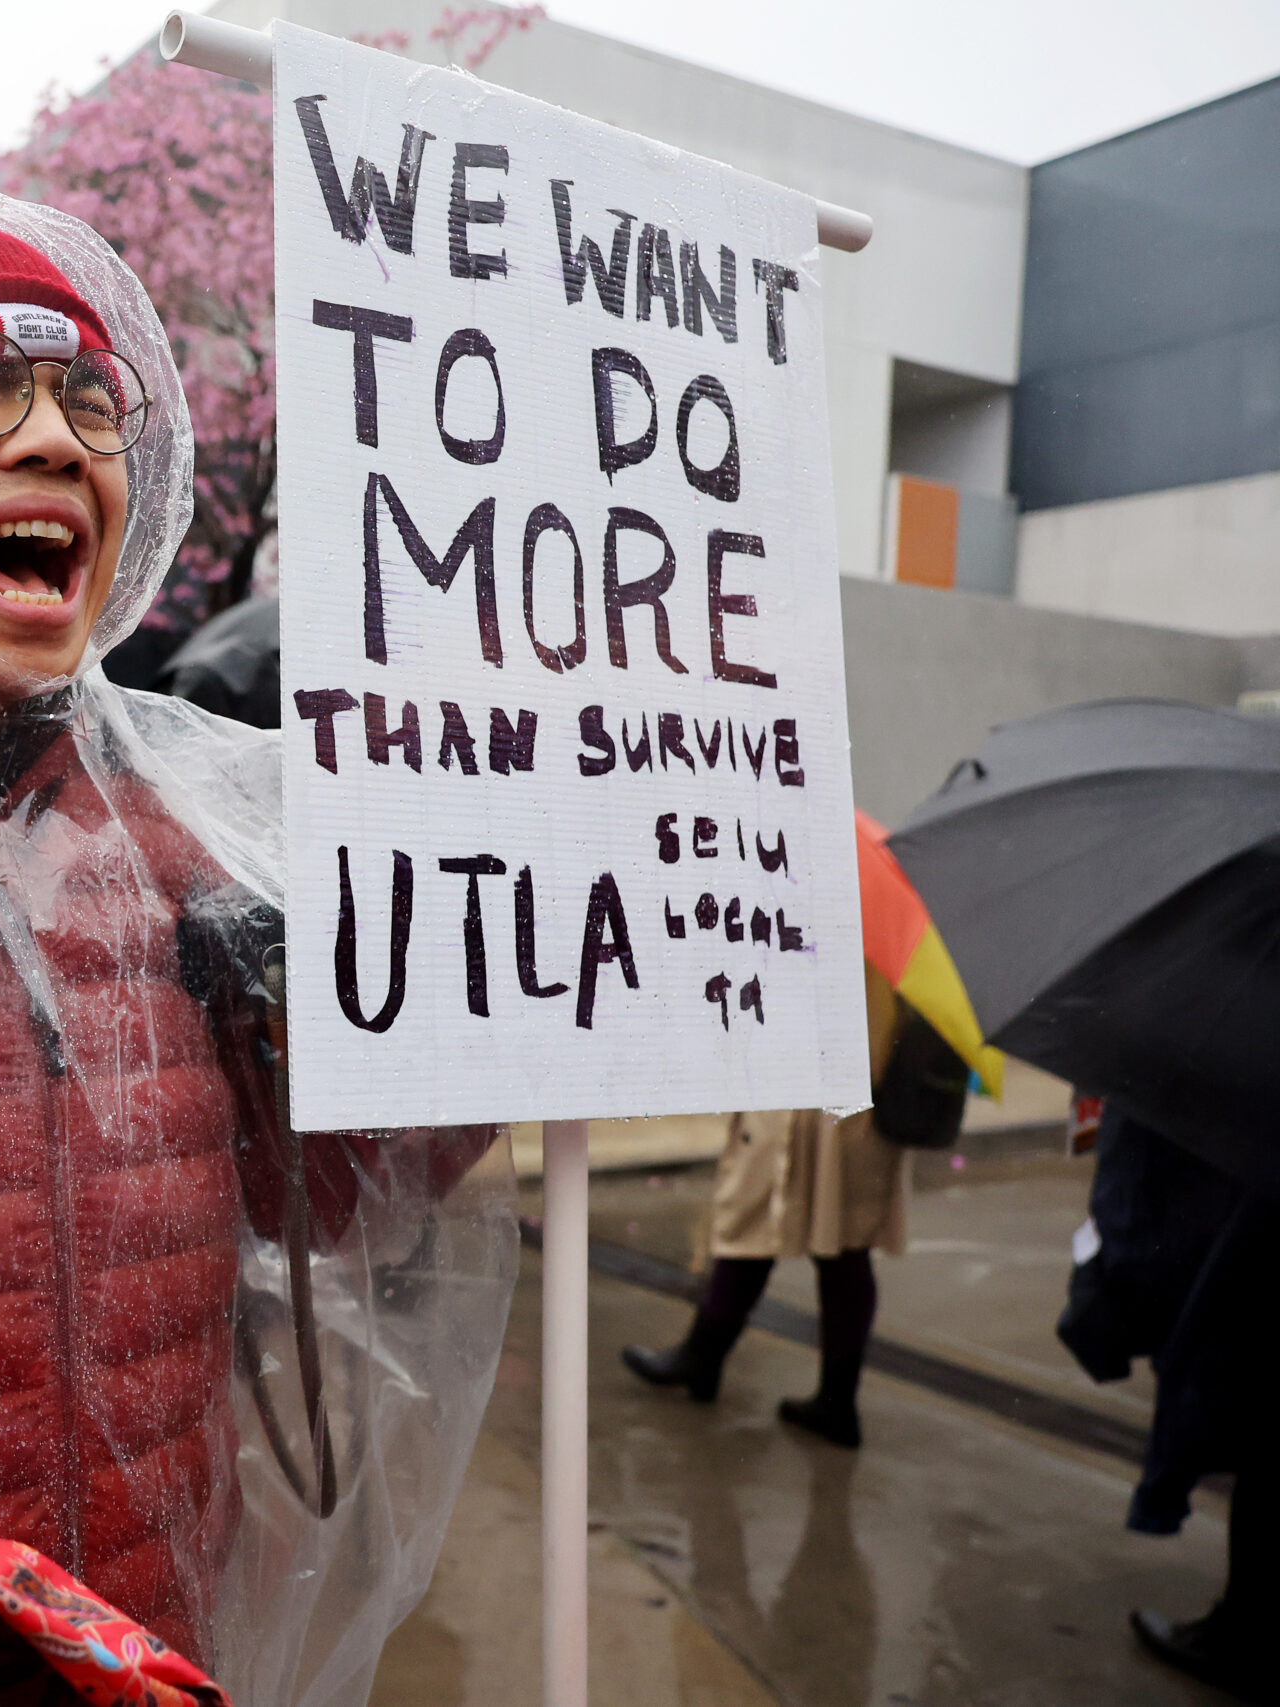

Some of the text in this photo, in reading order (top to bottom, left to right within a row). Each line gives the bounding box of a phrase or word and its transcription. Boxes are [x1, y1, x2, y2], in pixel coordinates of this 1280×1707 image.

[294, 93, 799, 366] WE WANT
[18, 324, 68, 335] FIGHT CLUB
[312, 298, 741, 503] TO DO
[363, 472, 778, 689] MORE
[292, 688, 805, 788] THAN SURVIVE
[654, 812, 789, 878] SEIU
[333, 844, 640, 1034] UTLA
[664, 892, 804, 952] LOCAL
[704, 970, 765, 1033] 99
